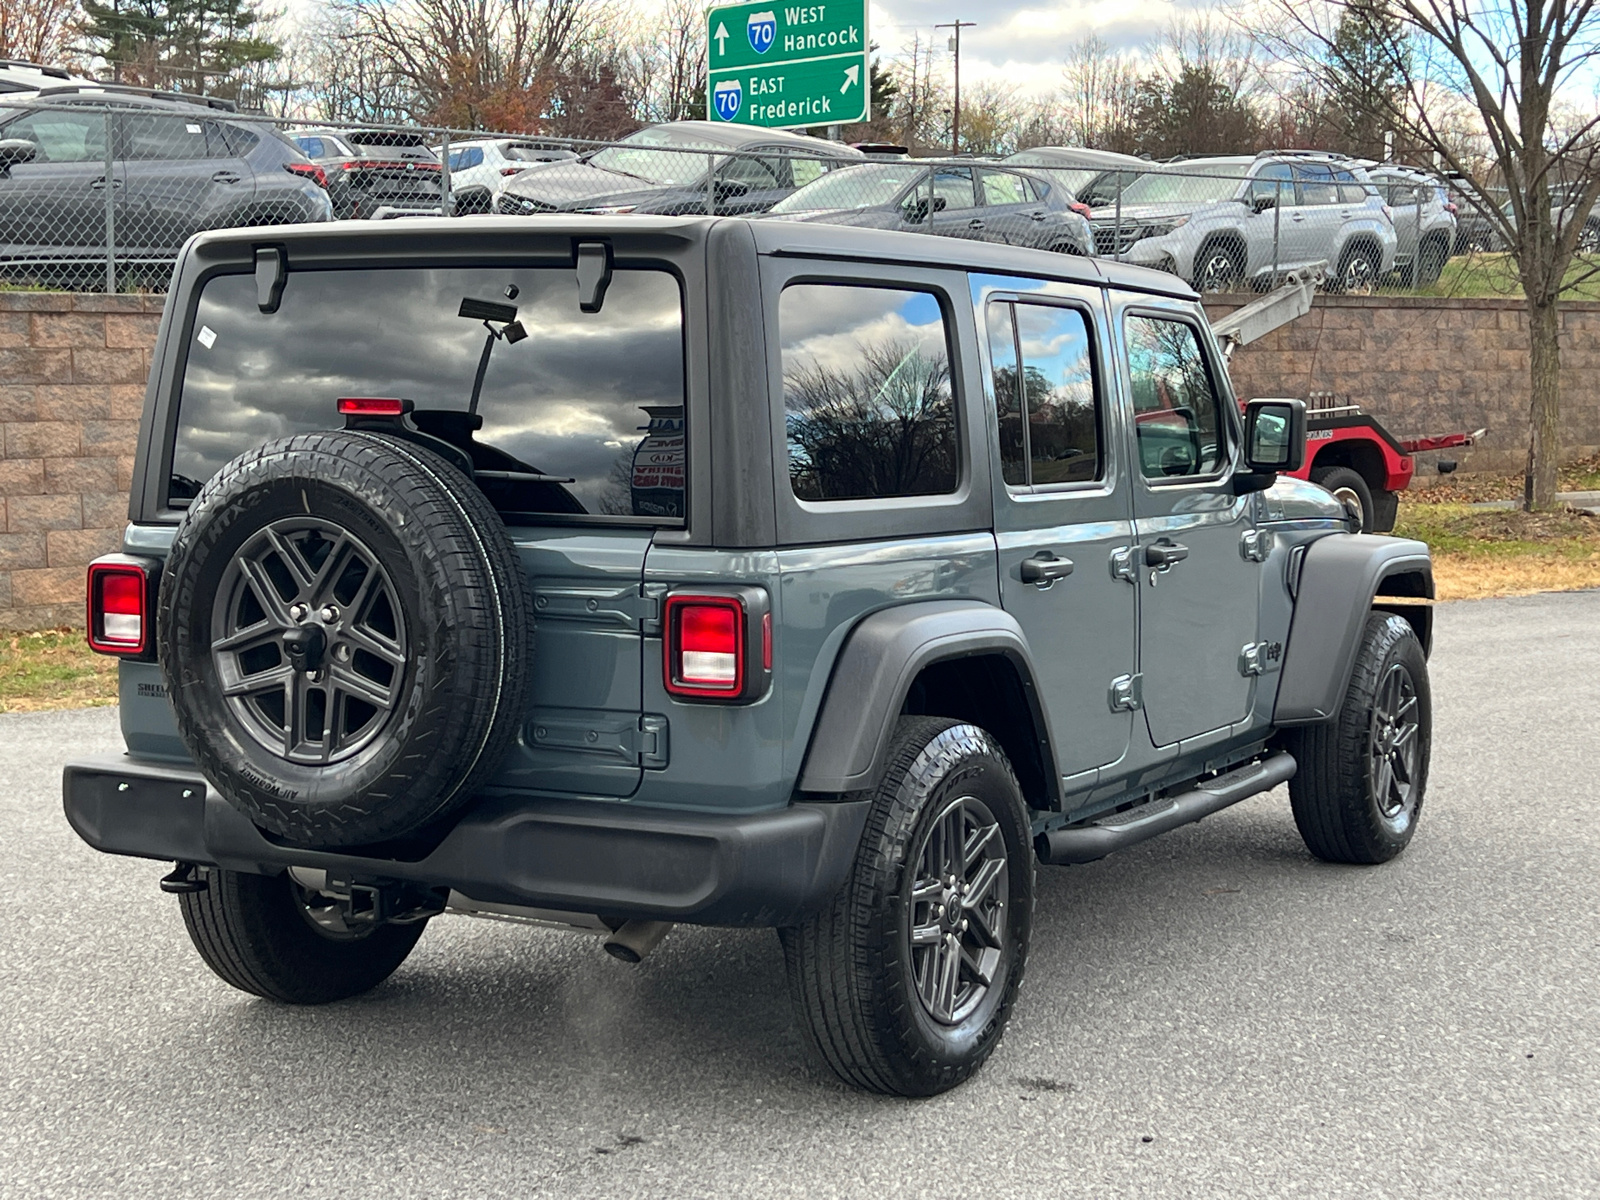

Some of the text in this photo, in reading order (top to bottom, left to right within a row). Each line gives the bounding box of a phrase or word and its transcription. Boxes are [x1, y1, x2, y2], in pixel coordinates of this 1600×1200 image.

[784, 6, 826, 26] WEST
[751, 24, 773, 45] 70
[784, 25, 859, 52] Hancock
[750, 77, 785, 96] EAST
[718, 92, 738, 113] 70
[750, 95, 832, 121] Frederick
